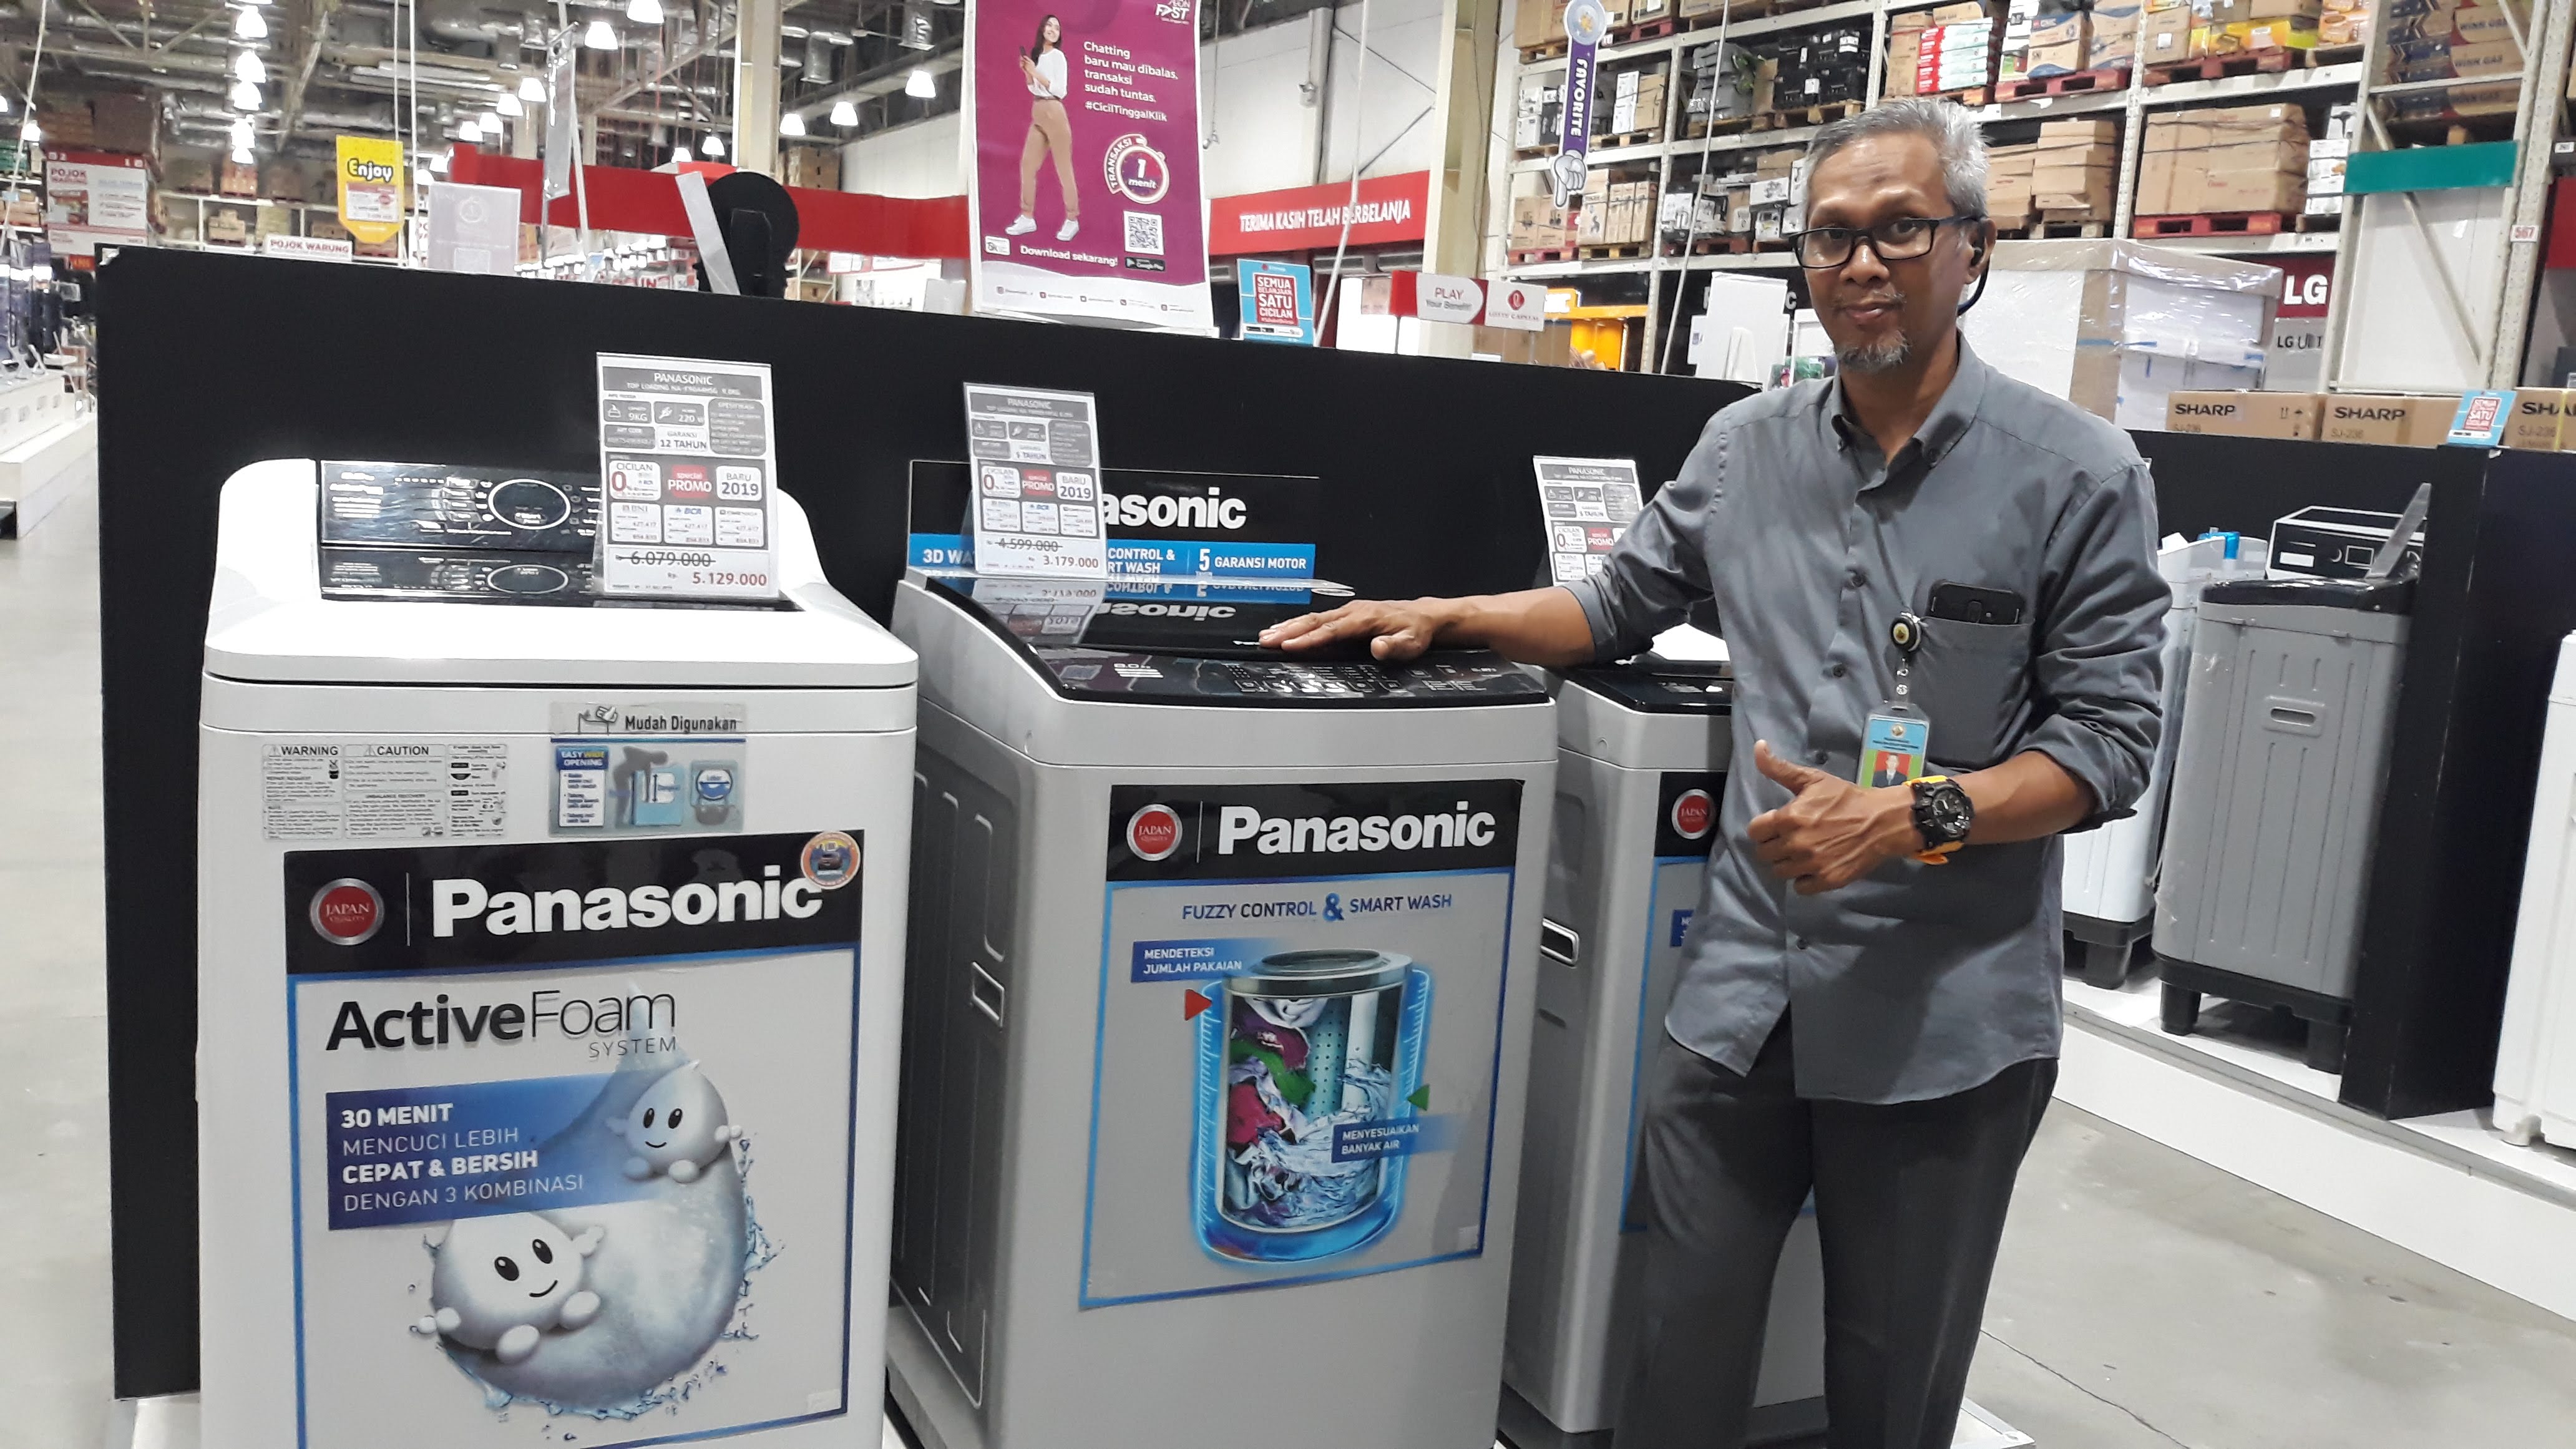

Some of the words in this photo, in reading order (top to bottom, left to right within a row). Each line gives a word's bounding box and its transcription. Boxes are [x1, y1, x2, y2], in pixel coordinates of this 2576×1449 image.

[1083, 41, 1131, 60] Chatting
[1084, 54, 1110, 68] baru
[1111, 61, 1136, 72] mau
[1084, 69, 1133, 85] transaksi
[1085, 83, 1119, 96] sudah
[1121, 88, 1157, 103] tuntas.
[1569, 57, 1589, 137] FAVORITE
[1085, 100, 1168, 122] #CicilTinggalKlik
[347, 158, 394, 183] Enjoy
[1107, 137, 1133, 188] TRANSAKSI
[1137, 158, 1147, 178] 1
[1128, 178, 1158, 189] menit
[1239, 213, 1275, 232] TERIMA
[1276, 210, 1306, 230] KASIH
[1307, 206, 1341, 228] TELAH
[270, 238, 305, 250] POJOK
[306, 242, 349, 254] WARUNG
[1020, 245, 1071, 261] Download
[1071, 252, 1118, 268] sekarang!
[1257, 276, 1292, 289] SEMUA
[2283, 274, 2329, 306] LG
[1258, 293, 1292, 310] SATU
[1435, 286, 1464, 301] PLAY
[1259, 307, 1293, 319] CICILAN
[2276, 335, 2294, 348] LG
[653, 372, 713, 386] PANASONIC
[2175, 403, 2236, 417] SHARP
[2334, 406, 2406, 421] SHARP
[659, 439, 671, 447] 12
[673, 439, 708, 449] TAHUN
[726, 472, 751, 482] BARU
[667, 479, 713, 492] PROMO
[721, 482, 759, 496] 2019
[1022, 479, 1055, 492] PROMO
[1060, 485, 1091, 499] 2019
[998, 537, 1059, 552] 4.599.000
[1587, 537, 1614, 547] PROMO
[630, 550, 711, 567] 6.079.000
[922, 549, 944, 564] 3D
[947, 549, 975, 564] WA
[1043, 555, 1099, 568] 3.179.000
[1108, 547, 1163, 561] CONTROL
[1165, 549, 1176, 561] &
[1199, 548, 1211, 571] 5
[1214, 556, 1265, 569] GARANSI
[1267, 557, 1307, 570] MOTOR
[1125, 562, 1161, 574] WASH
[692, 572, 768, 587] 5.129.000
[625, 715, 666, 731] Mudah
[671, 715, 737, 734] Digunakan
[280, 746, 338, 756] WARNING
[376, 746, 429, 756] CAUTION
[564, 758, 603, 766] OPENING
[1138, 825, 1172, 836] JAPAN
[1217, 800, 1496, 856] Panasonic
[326, 903, 369, 917] JAPAN
[432, 865, 824, 938] Panasonic
[1182, 903, 1237, 920] FUZZY
[1240, 900, 1317, 919] CONTROL
[1322, 892, 1345, 922] &
[1350, 896, 1404, 914] SMART
[1407, 894, 1452, 910] WASH
[1144, 947, 1215, 961] MENDETEKSI
[1143, 963, 1191, 975] JUMLAH
[1193, 960, 1242, 974] PAKAIAN
[588, 1036, 678, 1060] SYSTEM
[340, 1108, 374, 1129] 30
[377, 1103, 455, 1128] MENIT
[1342, 1123, 1420, 1141] MENYESUAIKAN
[343, 1132, 451, 1158] MENCUCI
[455, 1128, 520, 1149] LEBIH
[1341, 1141, 1382, 1156] BANYAK
[1383, 1139, 1400, 1153] AIR
[341, 1161, 424, 1186] CEPAT
[428, 1158, 446, 1179] &
[451, 1149, 539, 1178] BERSIH
[343, 1189, 439, 1214] DENGAN
[445, 1186, 457, 1205] 3
[464, 1174, 584, 1202] KOMBINASI
